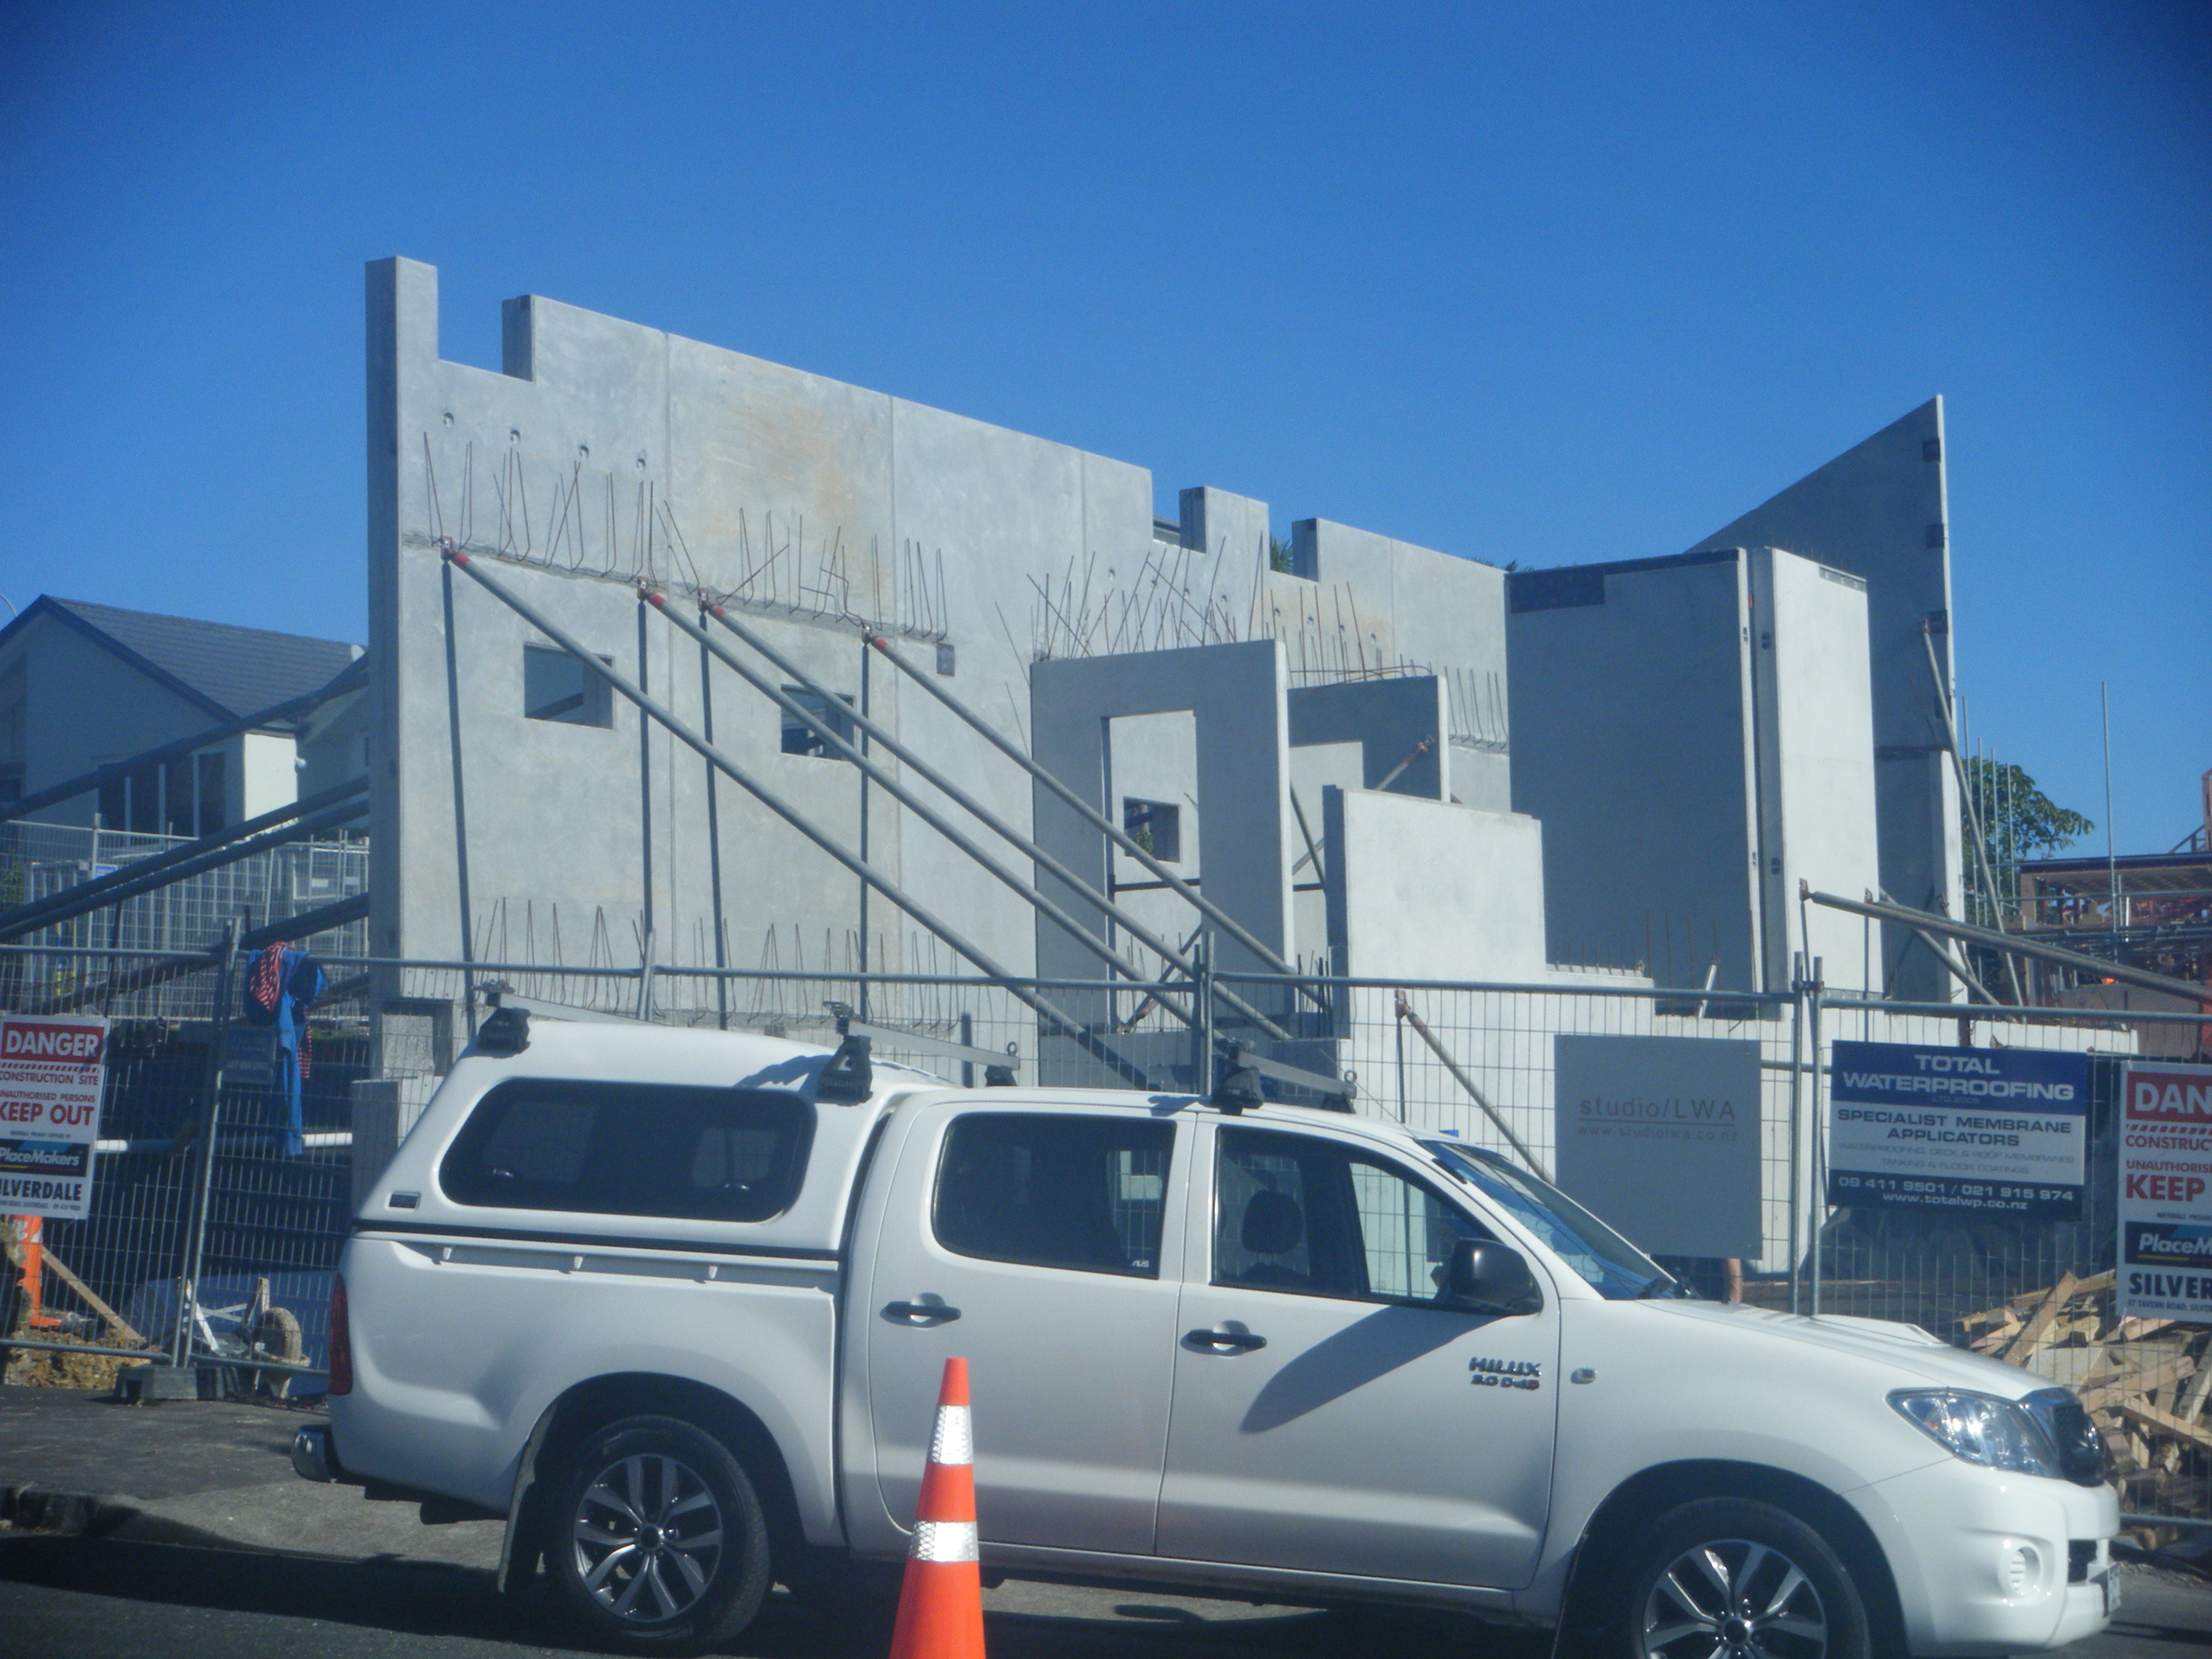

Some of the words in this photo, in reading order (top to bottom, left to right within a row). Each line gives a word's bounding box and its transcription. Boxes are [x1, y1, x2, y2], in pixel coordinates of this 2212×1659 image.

[5, 1030, 99, 1057] DANGER
[1915, 1054, 2000, 1074] TOTAL
[79, 1075, 98, 1085] SITE
[1843, 1071, 2074, 1101] WATERPROOFING
[61, 1094, 95, 1103] PERSONS
[1580, 1097, 1735, 1120] studio/LWA
[2135, 1082, 2212, 1114] DAN
[0, 1102, 43, 1122] KEEP
[50, 1104, 94, 1125] OUT
[1838, 1109, 1947, 1127] SPECIALIST
[1956, 1116, 2072, 1133] MEMBRANE
[1888, 1128, 2020, 1147] APPLICATORS
[1939, 1162, 1974, 1170] FLOOR
[1838, 1176, 1860, 1188] 09
[1865, 1178, 1896, 1190] 411
[1903, 1181, 1945, 1194] 9501
[1962, 1184, 1993, 1197] 021
[2001, 1187, 2034, 1199] 915
[2040, 1189, 2074, 1201] 974
[2126, 1174, 2205, 1202] KEEP
[1883, 1193, 2027, 1210] www.totalwp.co.nz
[1469, 1357, 1541, 1376] HILUX
